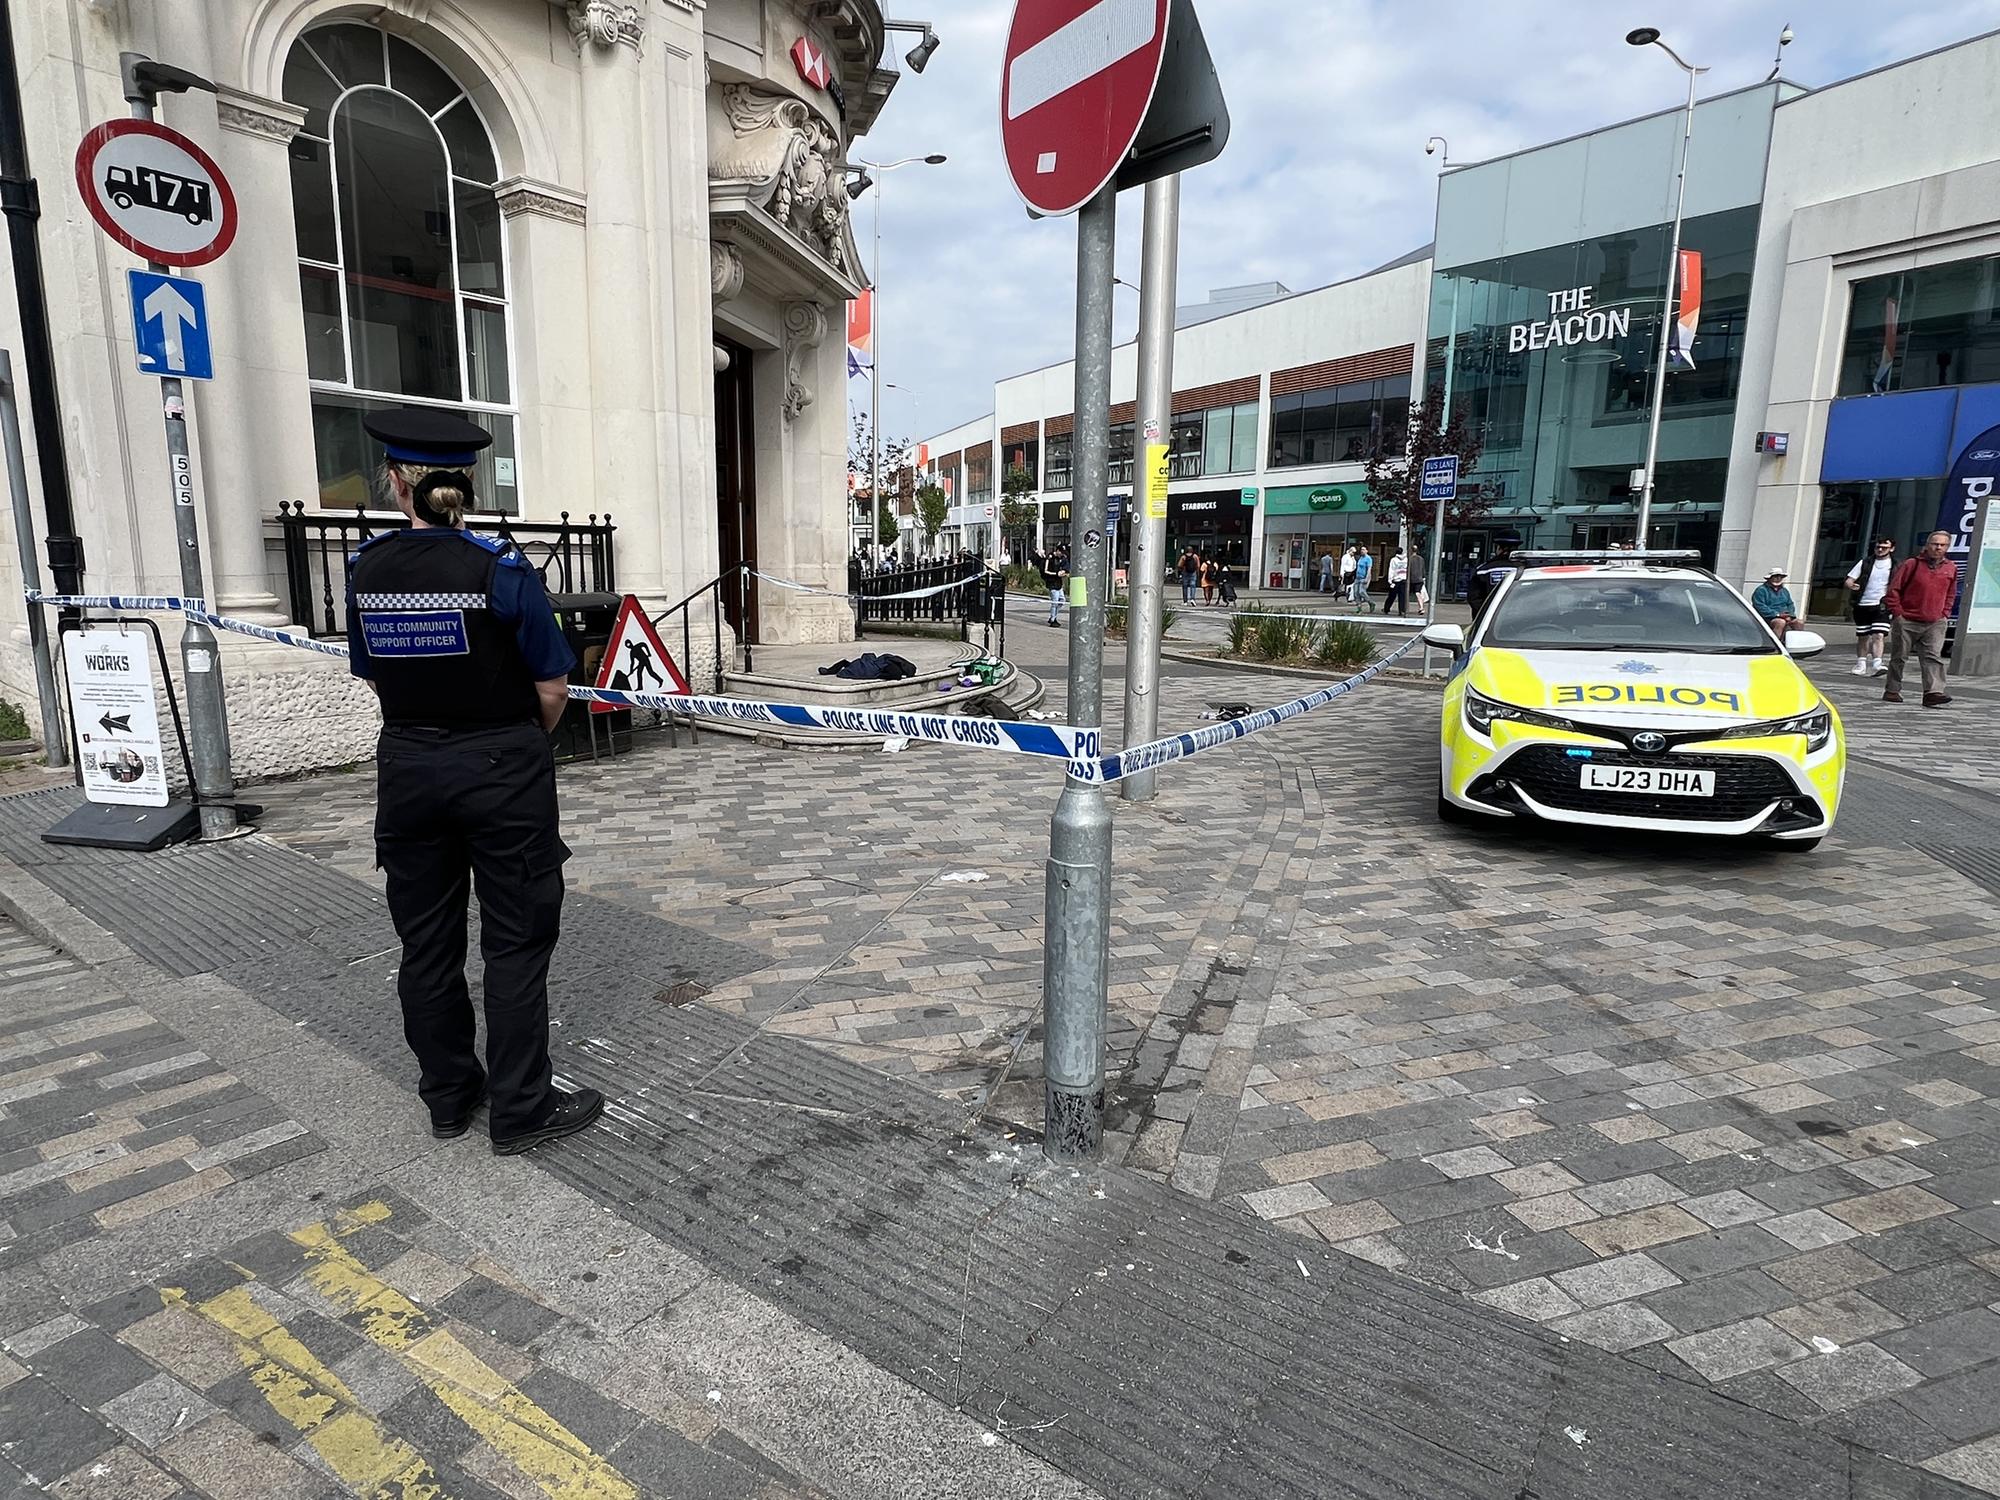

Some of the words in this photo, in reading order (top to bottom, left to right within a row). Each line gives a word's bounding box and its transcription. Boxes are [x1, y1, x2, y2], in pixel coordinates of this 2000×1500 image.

[1548, 286, 1593, 314] THE
[1509, 308, 1631, 353] BEACON
[1426, 462, 1438, 470] BUS
[1439, 460, 1455, 469] LANE
[1423, 488, 1438, 496] LOOK
[1439, 486, 1454, 495] LEFT
[1181, 501, 1217, 511] STARBUCKS
[1311, 494, 1342, 504] Specsavers
[365, 622, 395, 633] POLICE
[397, 620, 458, 633] COMMUNITY
[371, 637, 411, 648] SUPPORT
[414, 635, 457, 647] OFFICER
[85, 655, 130, 671] WORKS
[636, 695, 669, 710] POLICE
[669, 698, 692, 712] LINE
[692, 700, 711, 715] DO
[709, 701, 732, 717] NOT
[732, 703, 771, 721] CROSS
[822, 710, 868, 732] POLICE
[867, 712, 899, 735] LINE
[899, 715, 920, 737] DO
[921, 717, 949, 740] NOT
[952, 720, 1000, 746] CROSS
[1591, 768, 1651, 789] LJ23
[1658, 772, 1703, 793] DHA
